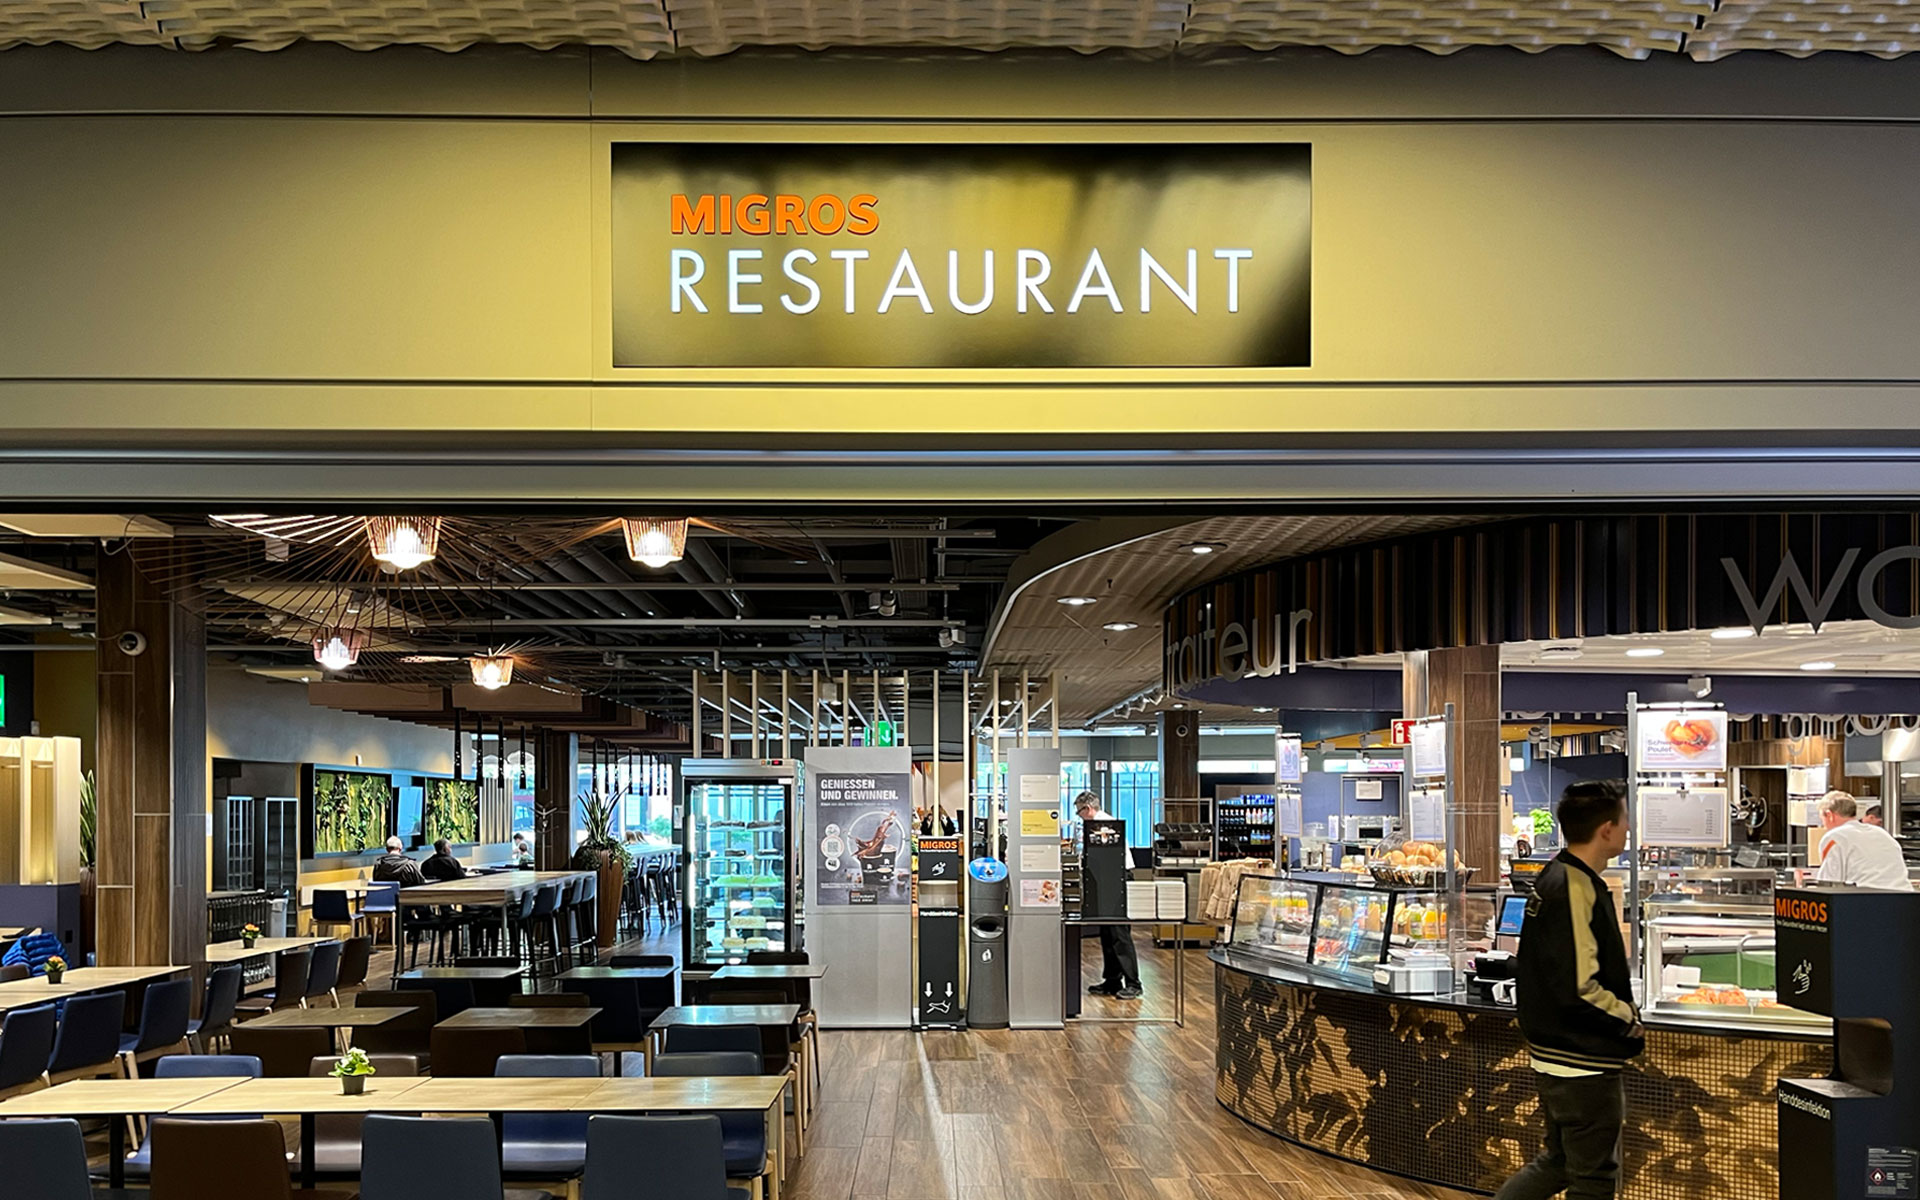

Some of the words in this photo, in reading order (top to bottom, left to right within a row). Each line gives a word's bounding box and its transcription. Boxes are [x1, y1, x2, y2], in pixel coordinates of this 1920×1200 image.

[670, 193, 880, 235] MIGROS
[669, 247, 1254, 315] RESTAURANT
[1166, 603, 1313, 697] traiteur
[820, 779, 875, 789] GENIESSEN
[820, 790, 841, 800] UND
[844, 790, 899, 800] GEWINNEN.
[920, 840, 958, 849] MIGROS
[1776, 897, 1828, 923] MIGROS
[1778, 1088, 1831, 1120] Handdesinfektion
